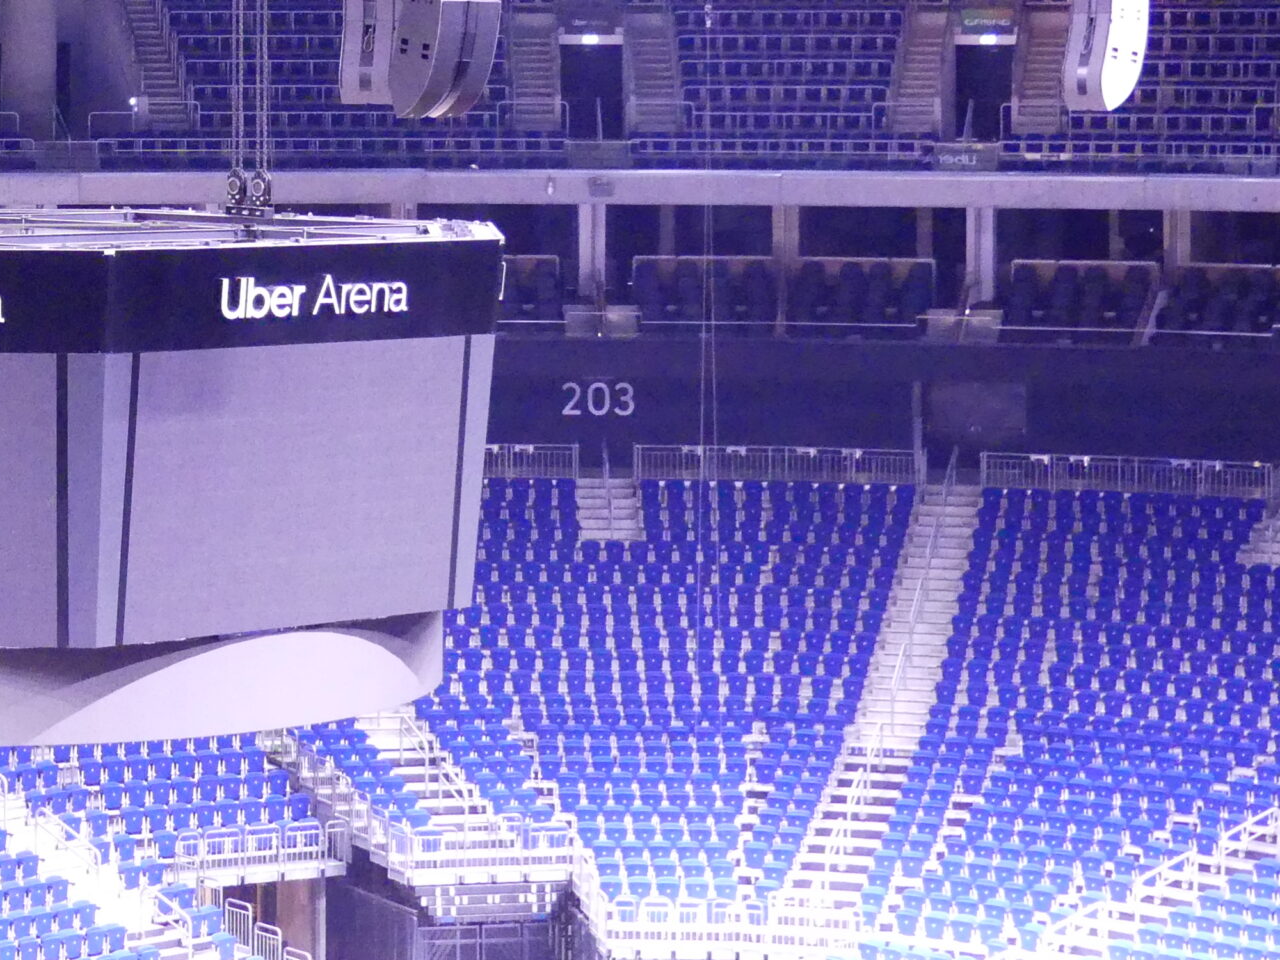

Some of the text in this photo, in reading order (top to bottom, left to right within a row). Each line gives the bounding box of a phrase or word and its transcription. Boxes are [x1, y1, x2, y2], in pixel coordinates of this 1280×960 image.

[220, 273, 409, 320] Uber Arena
[561, 382, 635, 416] 203
